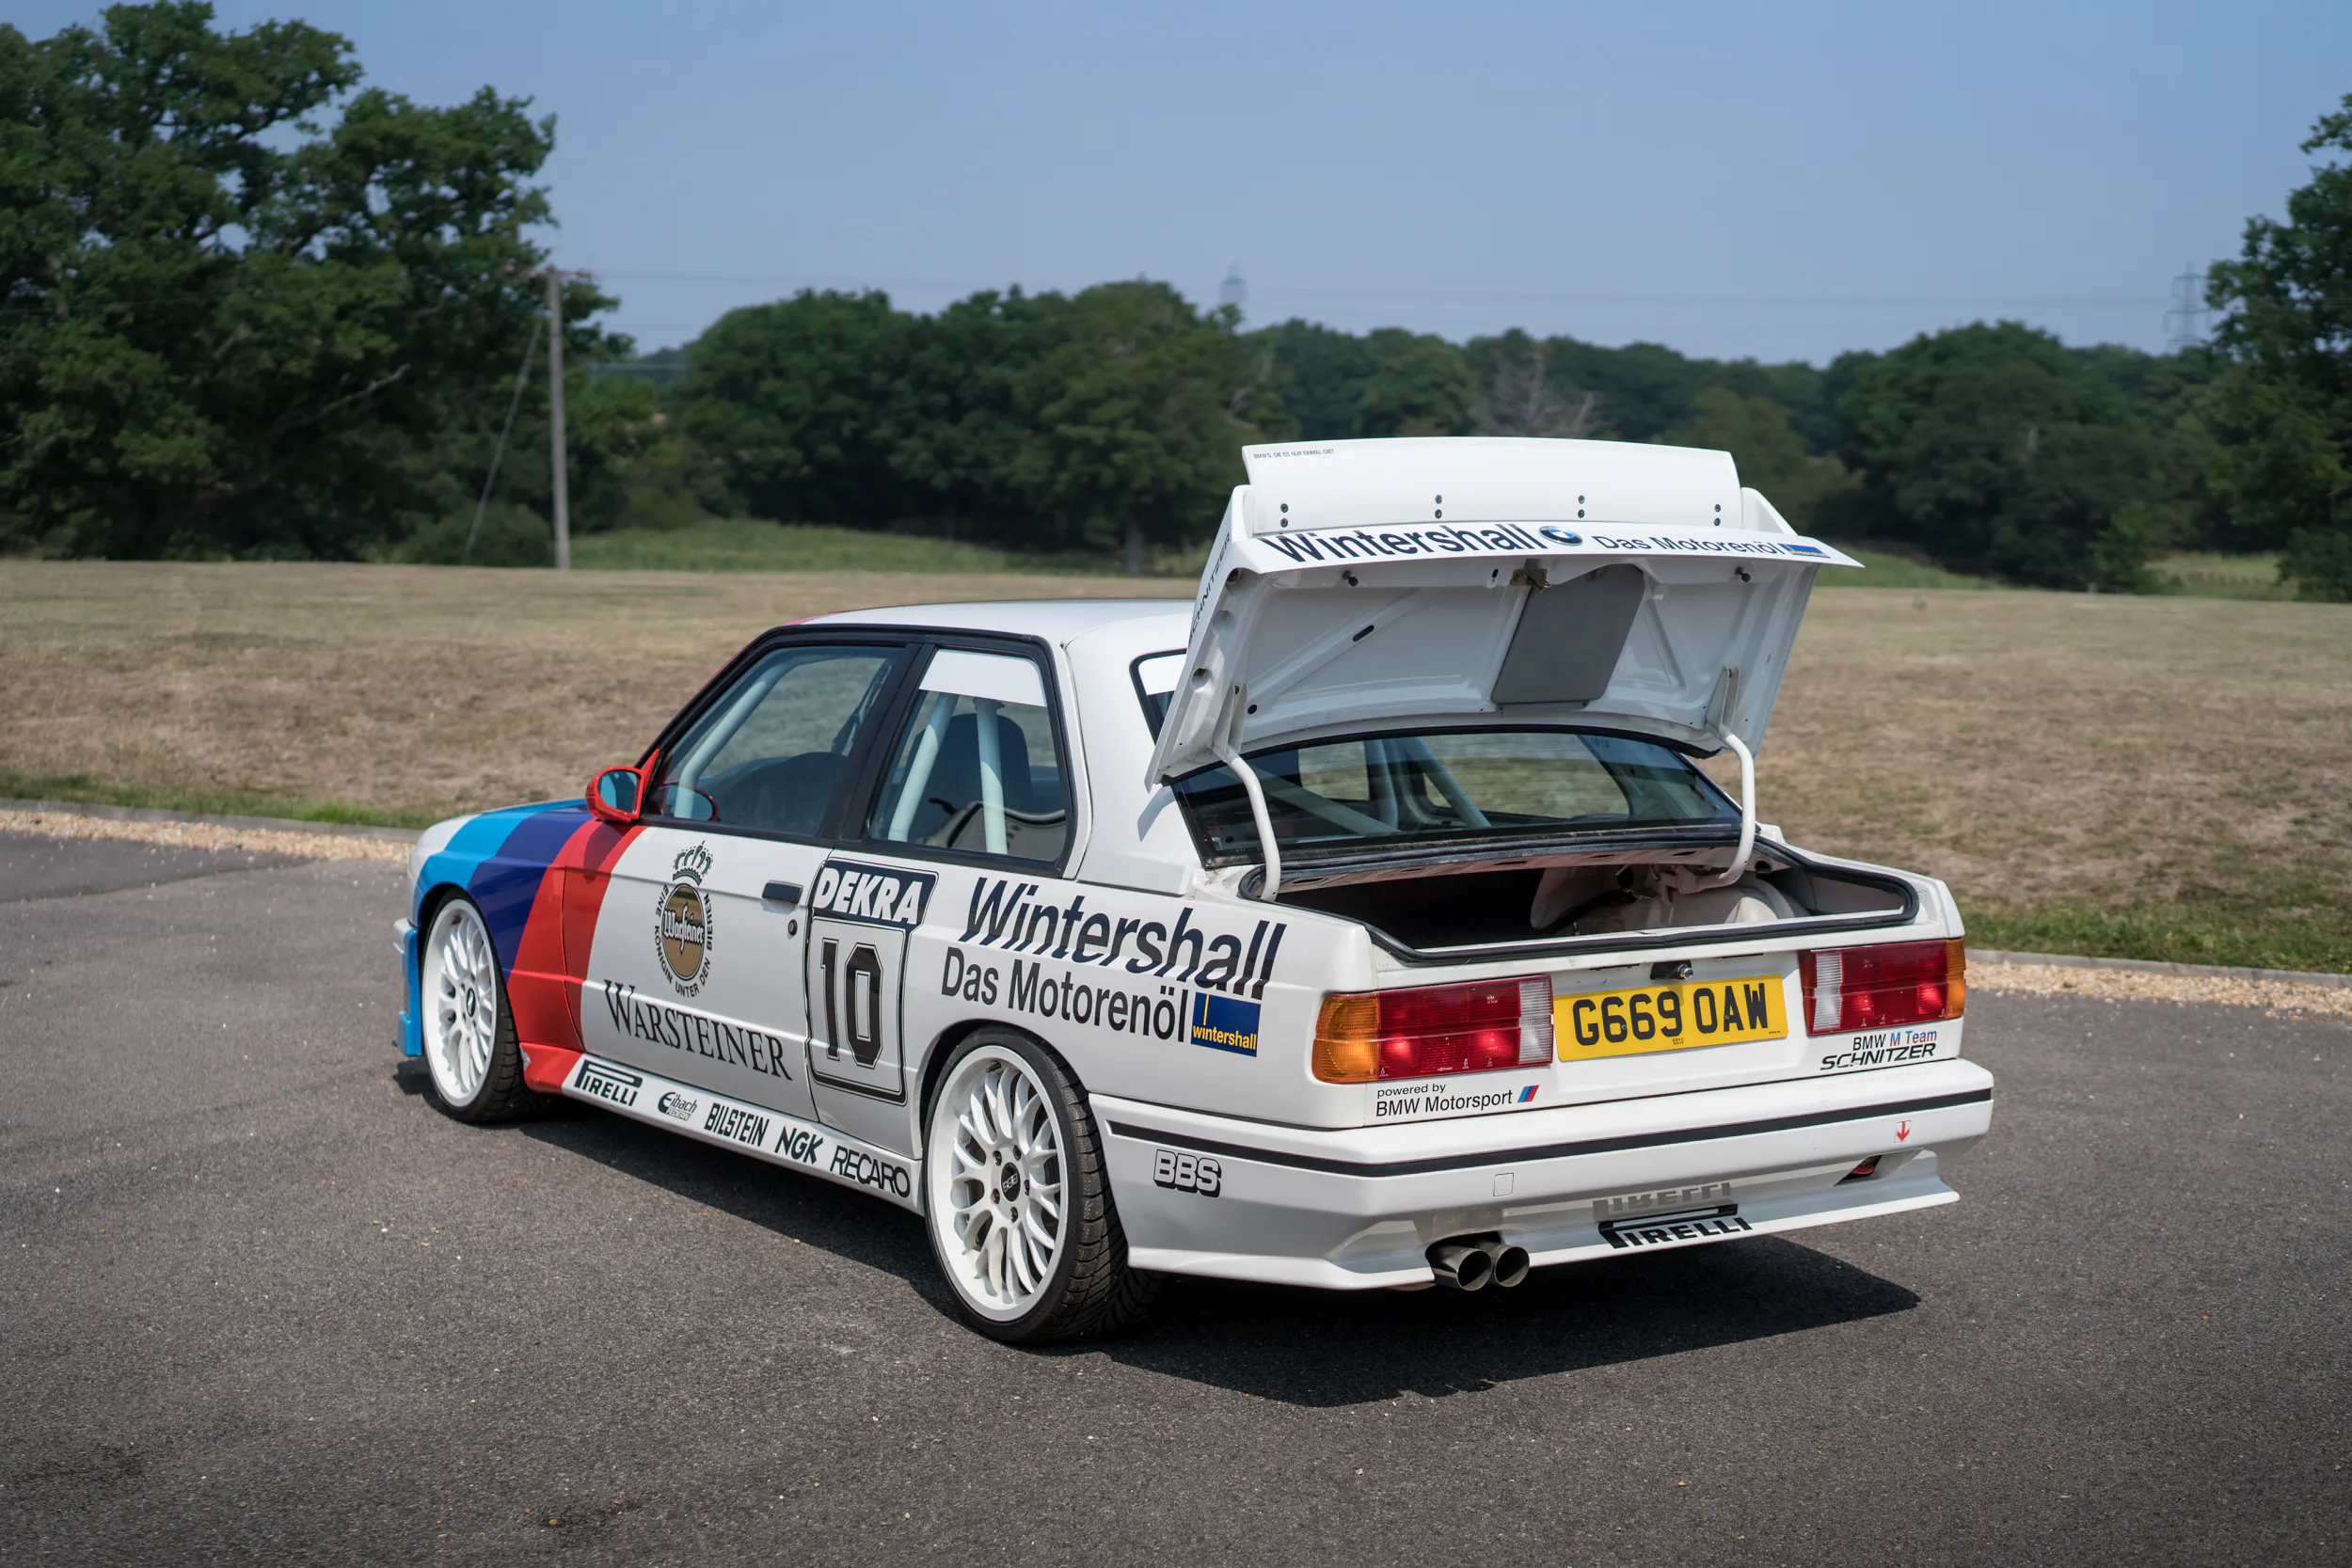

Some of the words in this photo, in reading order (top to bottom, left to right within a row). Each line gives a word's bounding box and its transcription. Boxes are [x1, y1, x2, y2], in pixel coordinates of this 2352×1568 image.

[1259, 523, 1549, 562] Wintershall
[1591, 535, 1651, 550] Das
[1648, 536, 1786, 555] Motorenöl
[655, 884, 670, 919] EINE
[813, 867, 924, 925] DEKRA
[704, 893, 713, 951] BIEREN
[959, 877, 1287, 1000] Wintershall
[655, 926, 674, 985] KÖNIGIN
[699, 958, 711, 987] DEN
[675, 980, 700, 998] UNTER
[820, 937, 883, 1069] 10
[942, 946, 999, 1006] Das
[1008, 958, 1189, 1043] Motorenöl
[604, 979, 793, 1082] WARSTEINER
[1193, 1023, 1258, 1051] wintershall
[1572, 990, 1683, 1046] G669
[1692, 983, 1769, 1034] OAW
[1820, 1042, 1936, 1070] SCHNITZER
[1852, 1034, 1886, 1052] BMW
[1889, 1031, 1900, 1047] M
[1905, 1029, 1937, 1044] Team
[574, 1059, 644, 1106] PIRELLI
[658, 1091, 698, 1115] Eibach
[1375, 1098, 1421, 1117] BMW
[1424, 1089, 1513, 1113] Motorsport
[1376, 1084, 1429, 1100] powered
[1432, 1083, 1446, 1094] by
[704, 1102, 770, 1147] BILSTEIN
[774, 1125, 824, 1164] NGK
[829, 1145, 911, 1198] RECARO
[1153, 1148, 1222, 1197] BBS
[1597, 1203, 1753, 1249] PIRELLI
